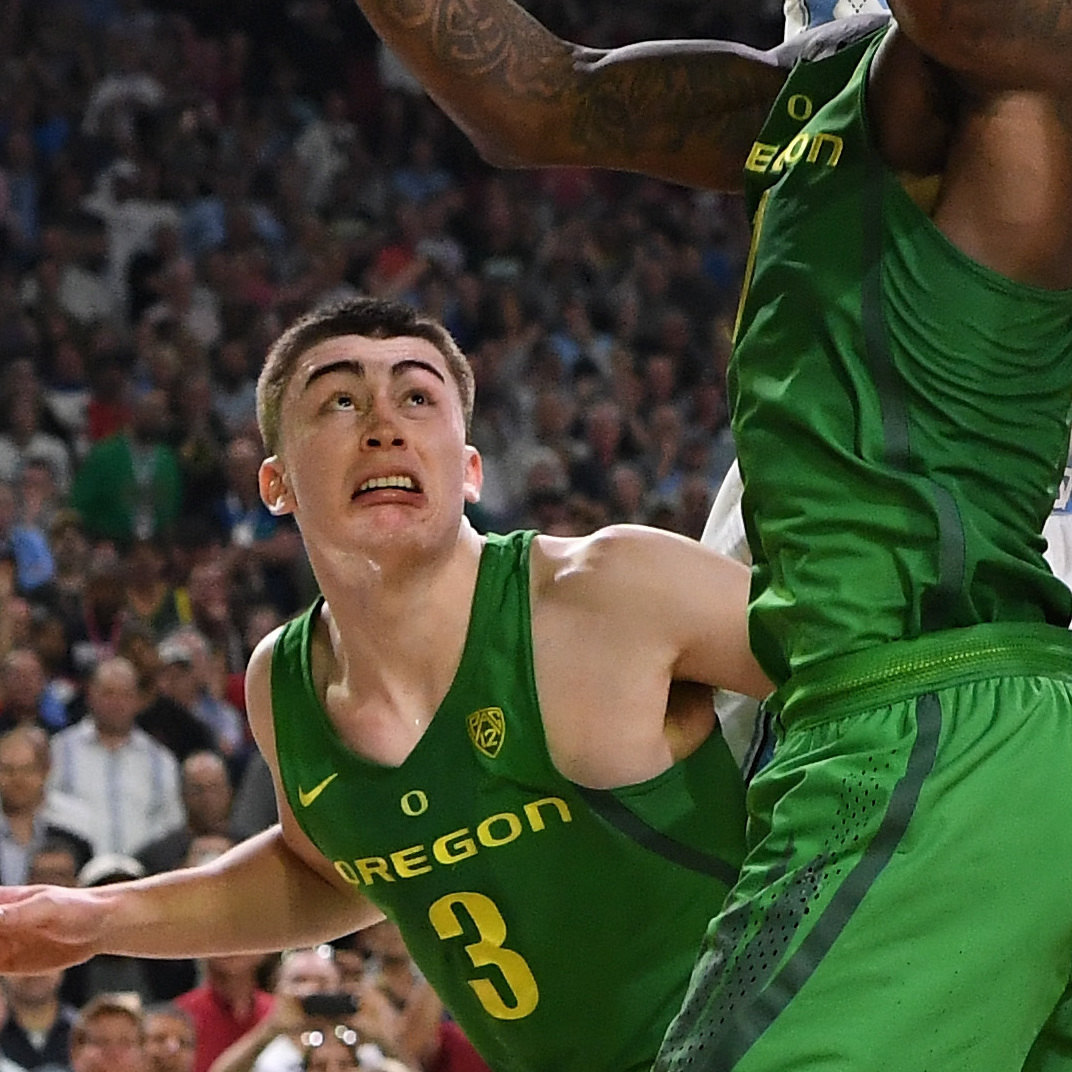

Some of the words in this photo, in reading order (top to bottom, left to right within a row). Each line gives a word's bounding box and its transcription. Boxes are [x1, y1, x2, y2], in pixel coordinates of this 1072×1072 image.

[480, 728, 499, 748] 12
[400, 789, 429, 817] O
[333, 796, 573, 886] OREGON
[428, 890, 540, 1021] 3
